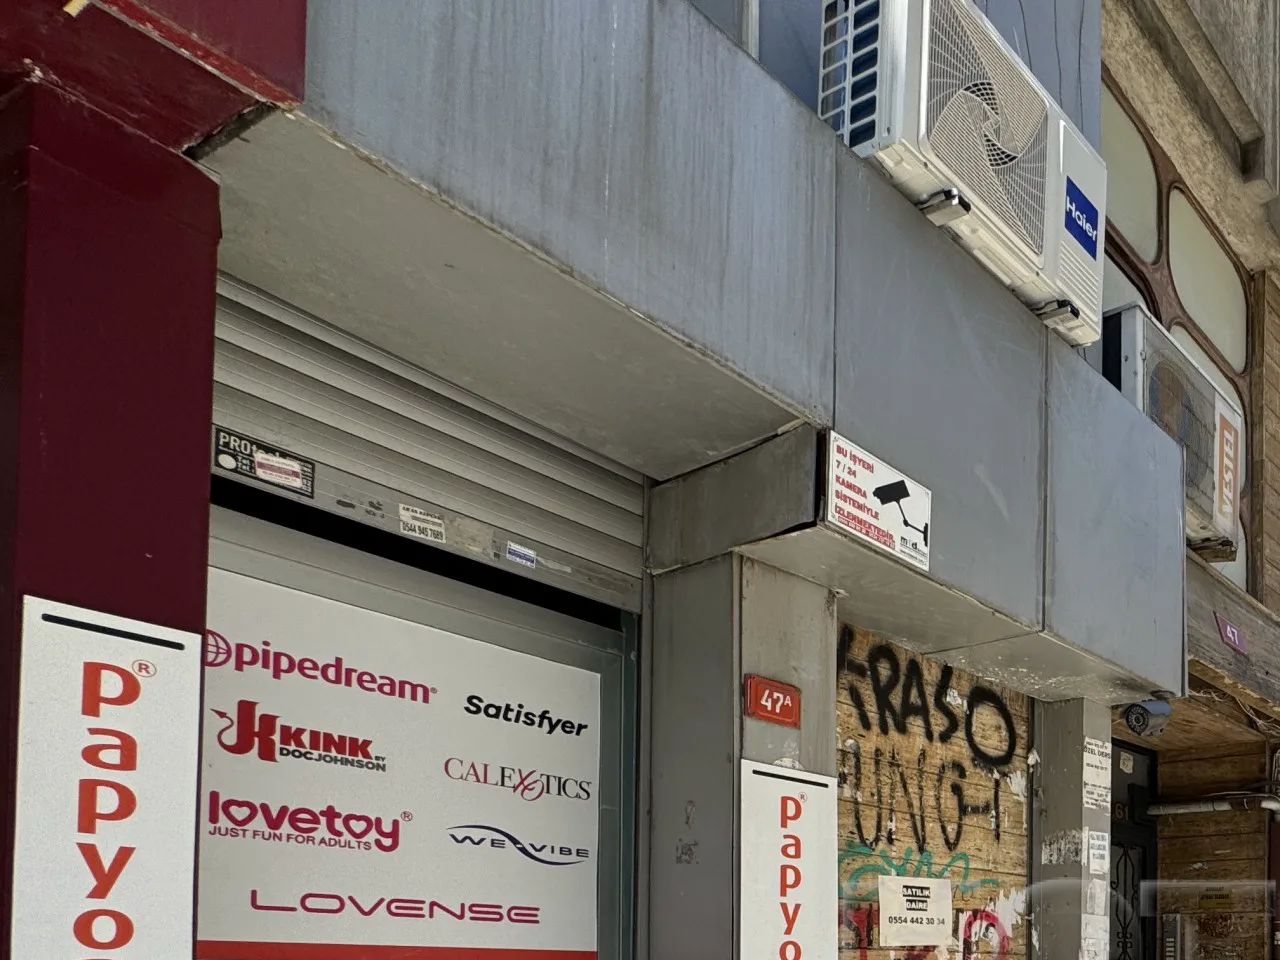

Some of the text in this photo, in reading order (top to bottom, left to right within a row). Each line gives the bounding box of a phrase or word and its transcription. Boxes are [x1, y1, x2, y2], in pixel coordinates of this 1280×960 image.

[1066, 195, 1097, 242] Haier
[835, 444, 875, 474] BU İŞYERİ
[846, 466, 858, 479] 24
[1222, 429, 1236, 514] VESTEL
[835, 474, 868, 500] KAMERA
[835, 489, 880, 521] SİSTEMİYLE
[1225, 624, 1239, 645] 47
[234, 640, 430, 704] pipedream
[464, 694, 589, 737] Satisfyer
[279, 723, 374, 761] KINK
[374, 755, 387, 763] BY
[208, 789, 400, 853] lovetoy
[208, 825, 372, 851] JUST FUN FOR ADULTS
[449, 833, 590, 859] WE VIBE
[902, 886, 931, 898] SATILIK
[905, 900, 928, 911] DAİRE
[249, 889, 541, 925] LOVENSE
[888, 915, 908, 925] 0554
[909, 916, 924, 926] 442
[925, 917, 935, 926] 30
